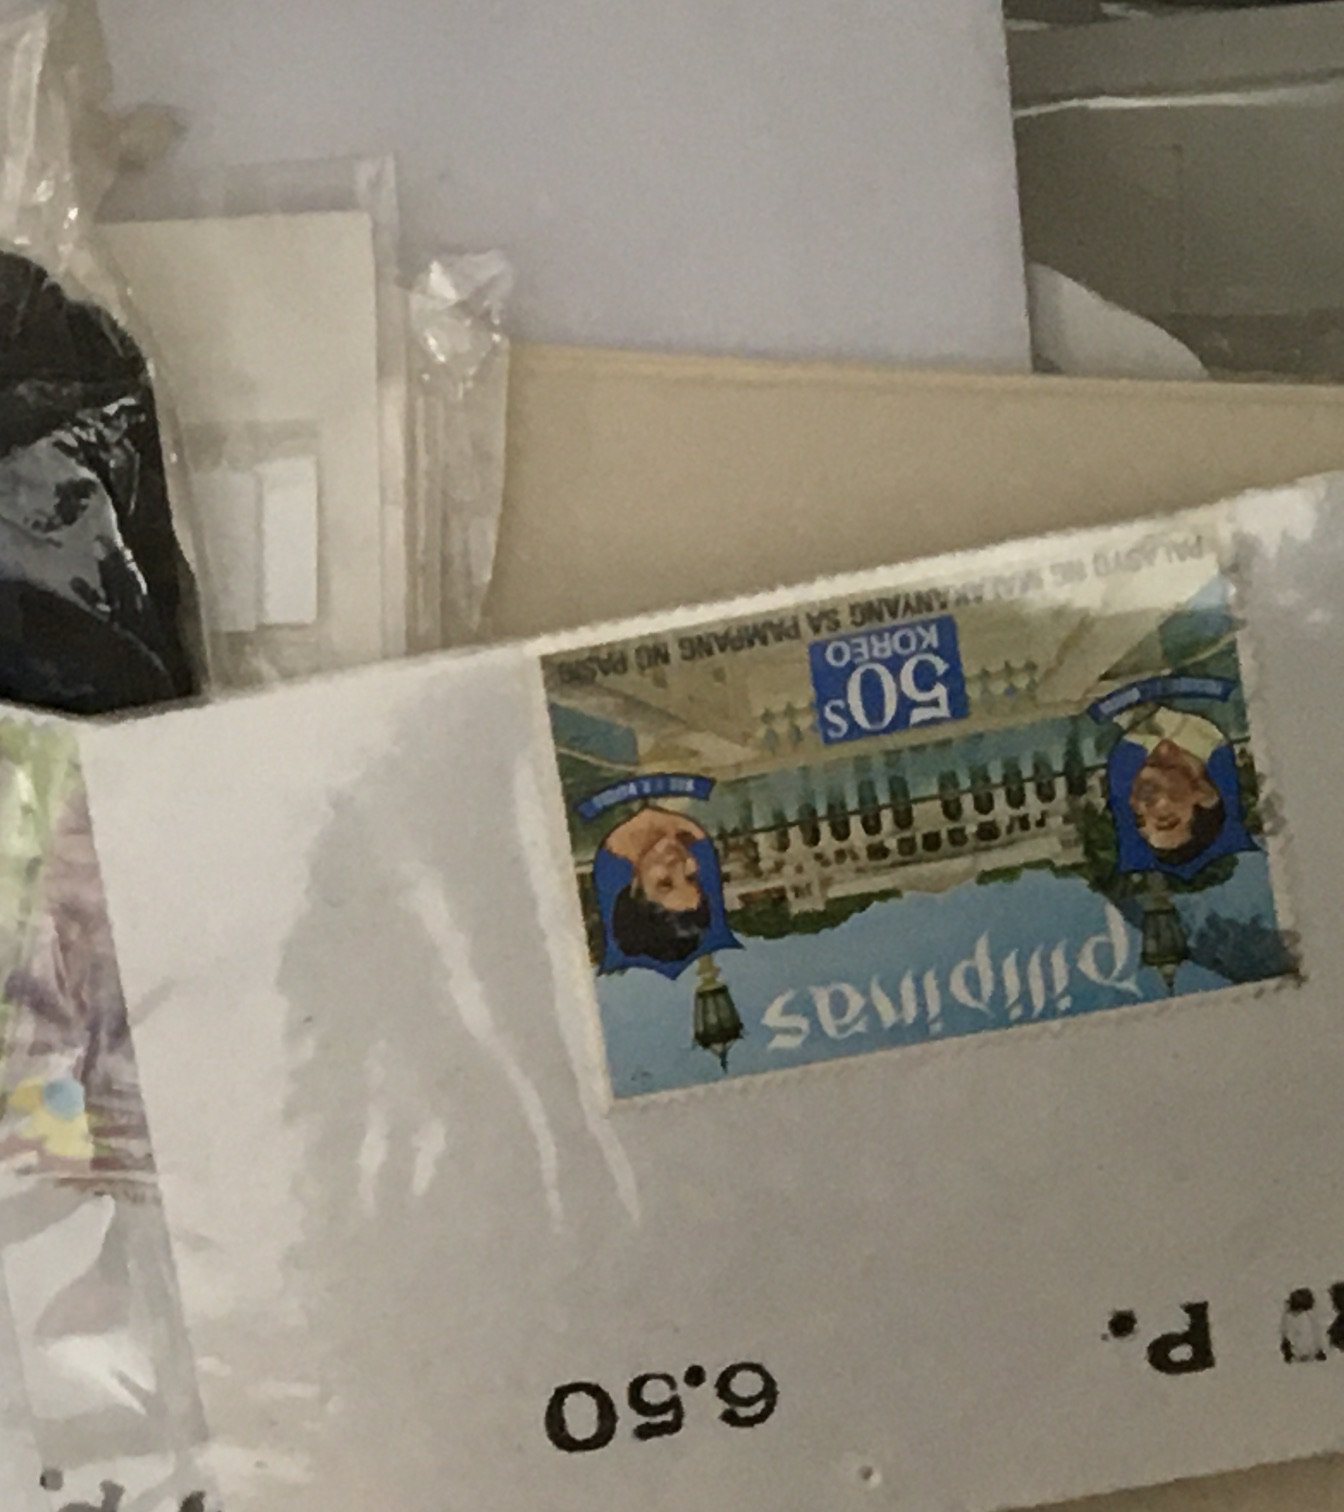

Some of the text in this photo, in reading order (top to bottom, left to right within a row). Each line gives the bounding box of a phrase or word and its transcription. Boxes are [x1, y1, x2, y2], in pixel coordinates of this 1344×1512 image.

[677, 613, 801, 661] PAMPANG
[806, 606, 842, 636] SA
[826, 624, 938, 667] KOREO
[545, 1362, 778, 1452] 6.50
